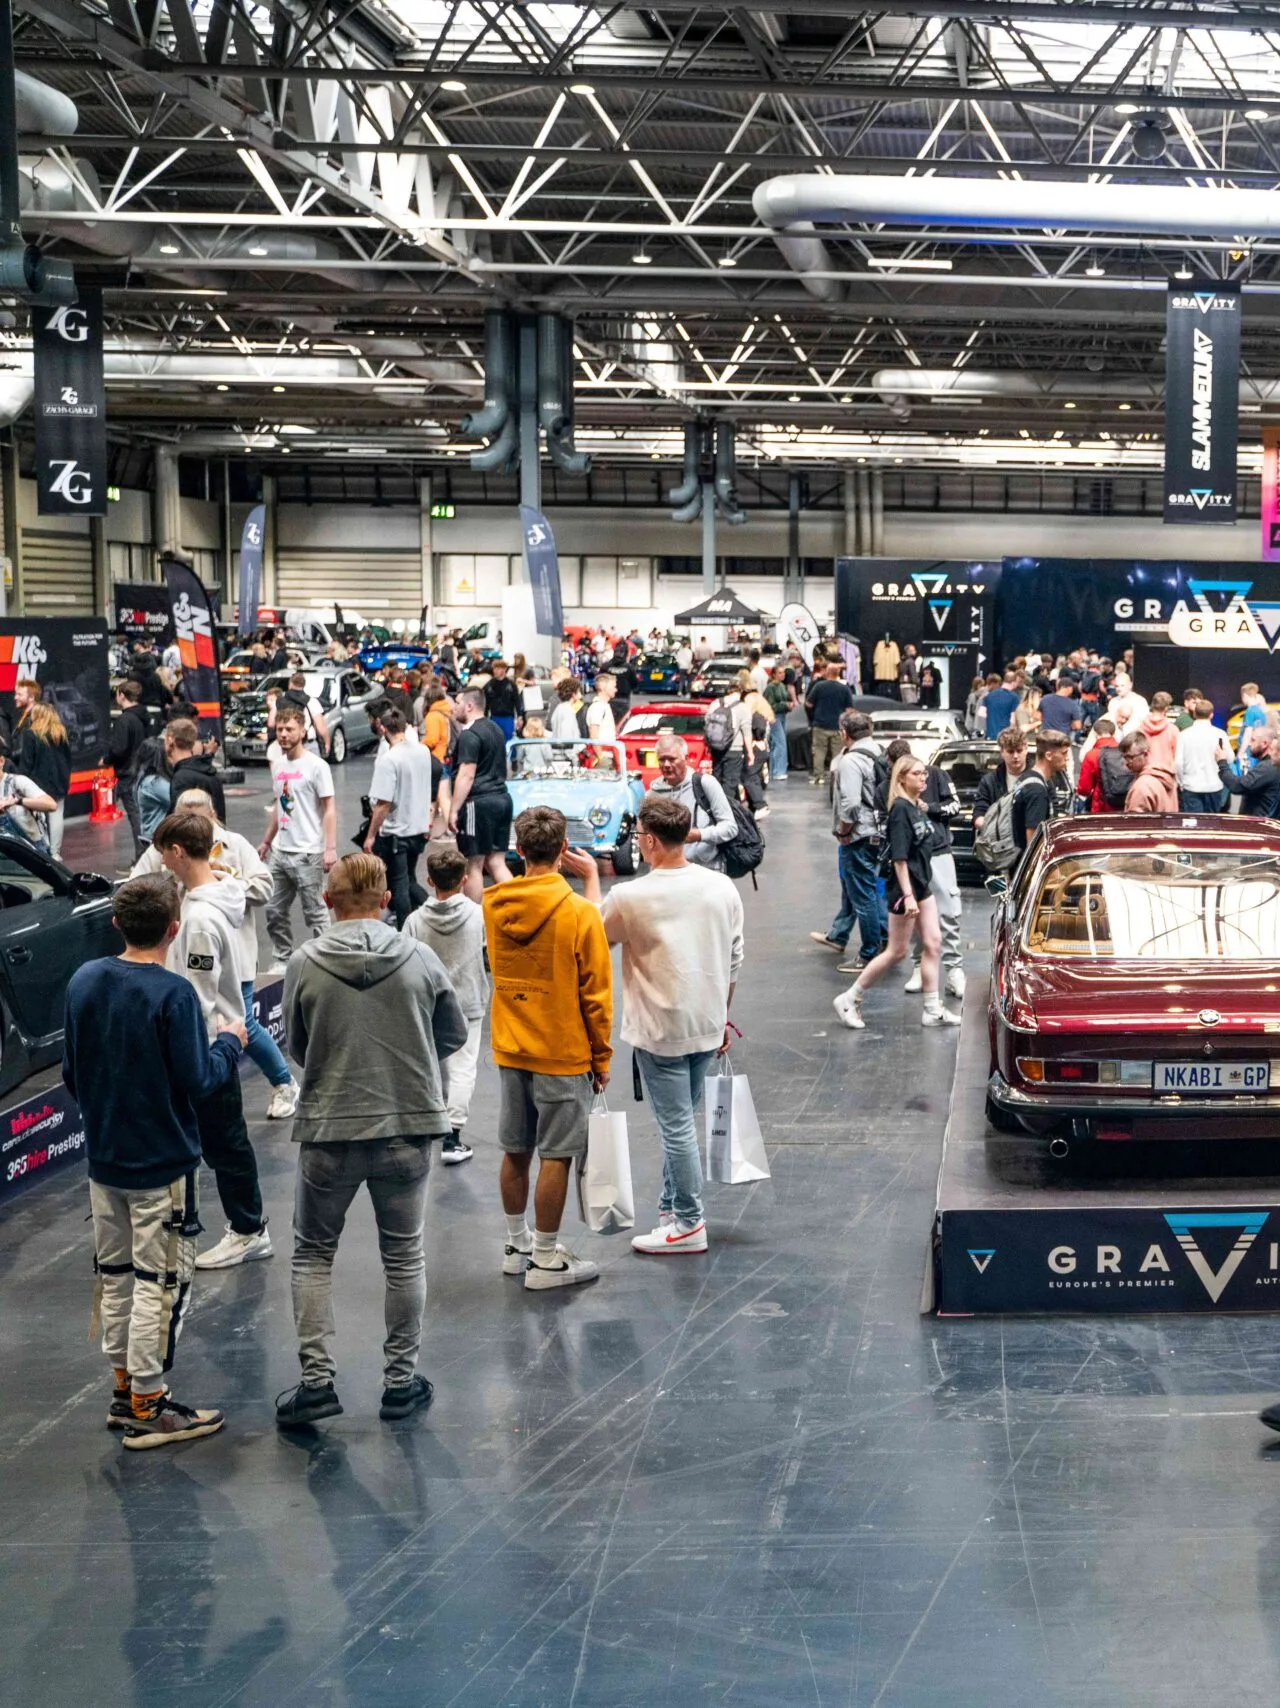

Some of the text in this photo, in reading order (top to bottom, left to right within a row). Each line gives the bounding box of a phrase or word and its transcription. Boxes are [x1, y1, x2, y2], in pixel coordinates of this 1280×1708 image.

[1172, 292, 1236, 314] GRAVITY
[61, 386, 78, 404] ZG
[49, 460, 92, 504] ZG
[1168, 488, 1232, 510] GRAVITY
[12, 634, 47, 664] K&
[1164, 1066, 1266, 1087] NKABI GP
[47, 1131, 86, 1161] Prestige
[1048, 1280, 1112, 1289] EUROPE'S
[1118, 1279, 1176, 1288] PREMIER
